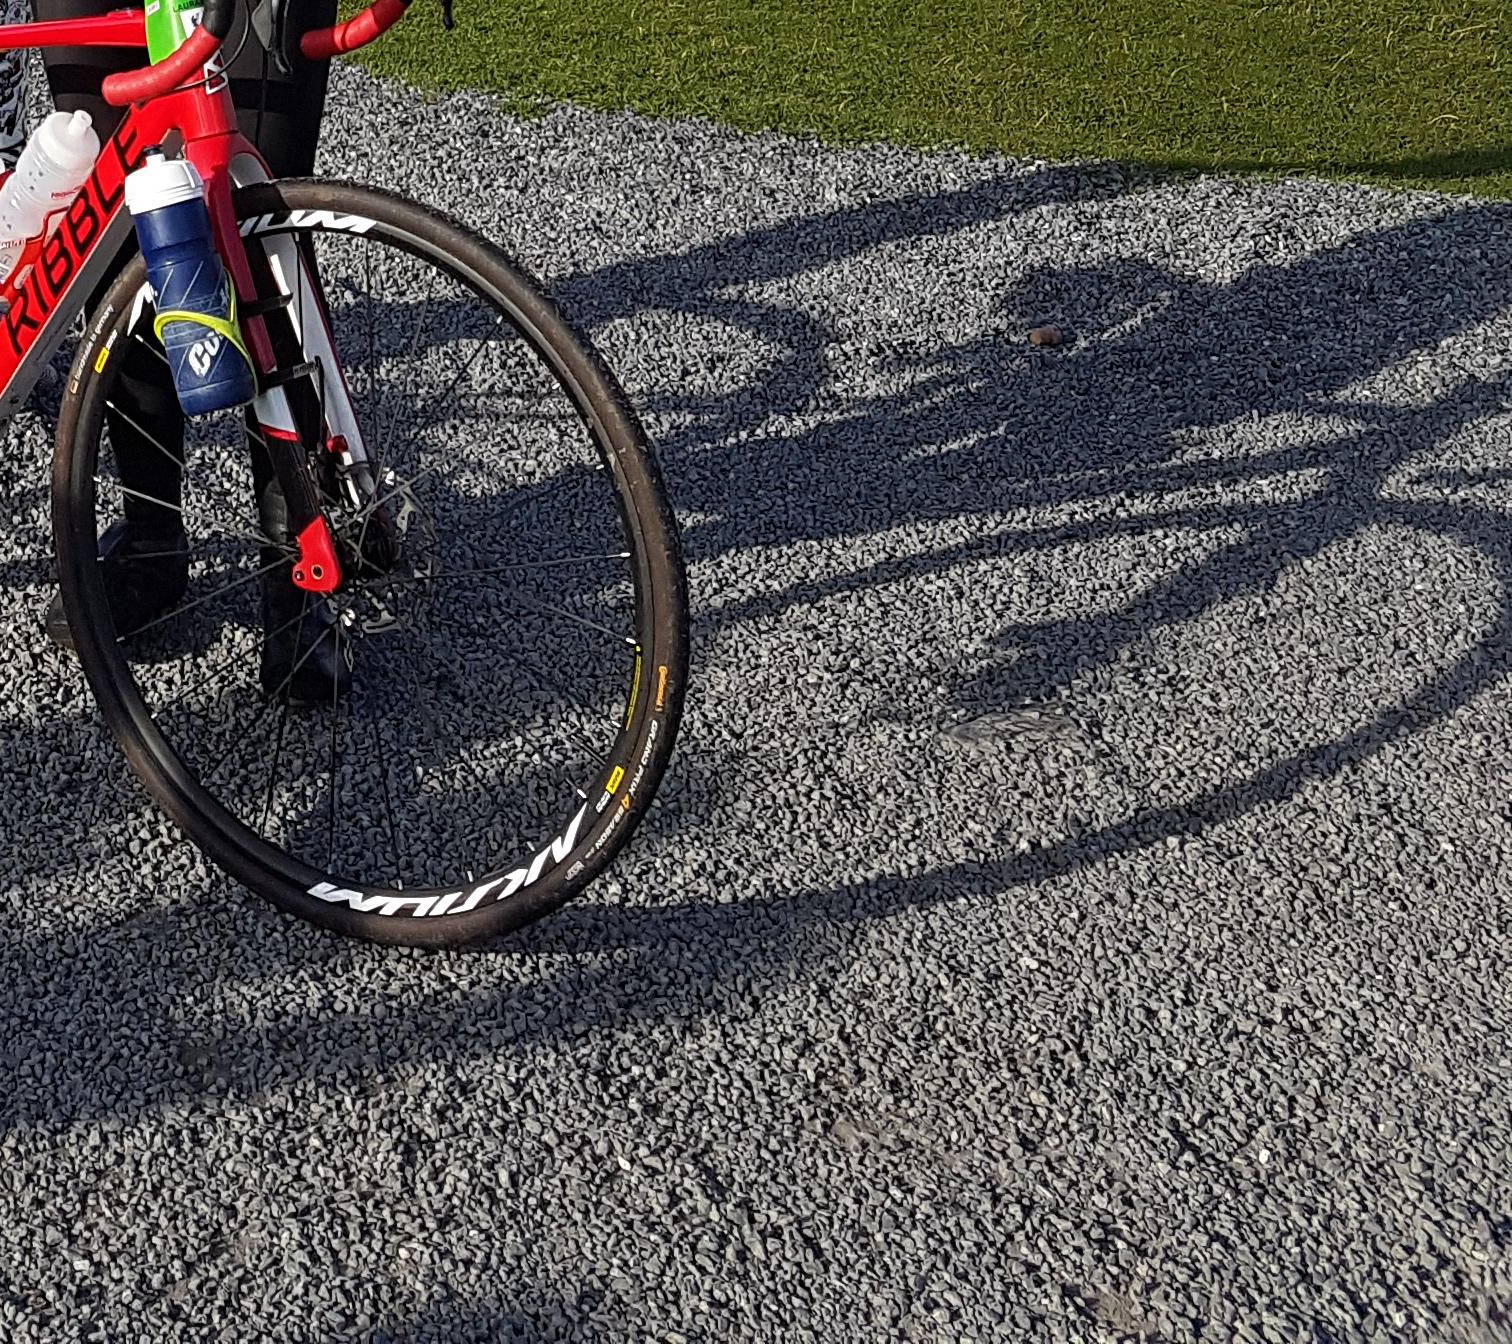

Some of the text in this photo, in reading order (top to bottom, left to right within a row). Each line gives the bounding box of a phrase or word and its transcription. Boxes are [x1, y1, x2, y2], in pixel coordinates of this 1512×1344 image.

[4, 123, 141, 356] RIBBLE
[640, 719, 658, 766] GRAND
[628, 764, 645, 796] PRIX
[620, 793, 630, 810] 4
